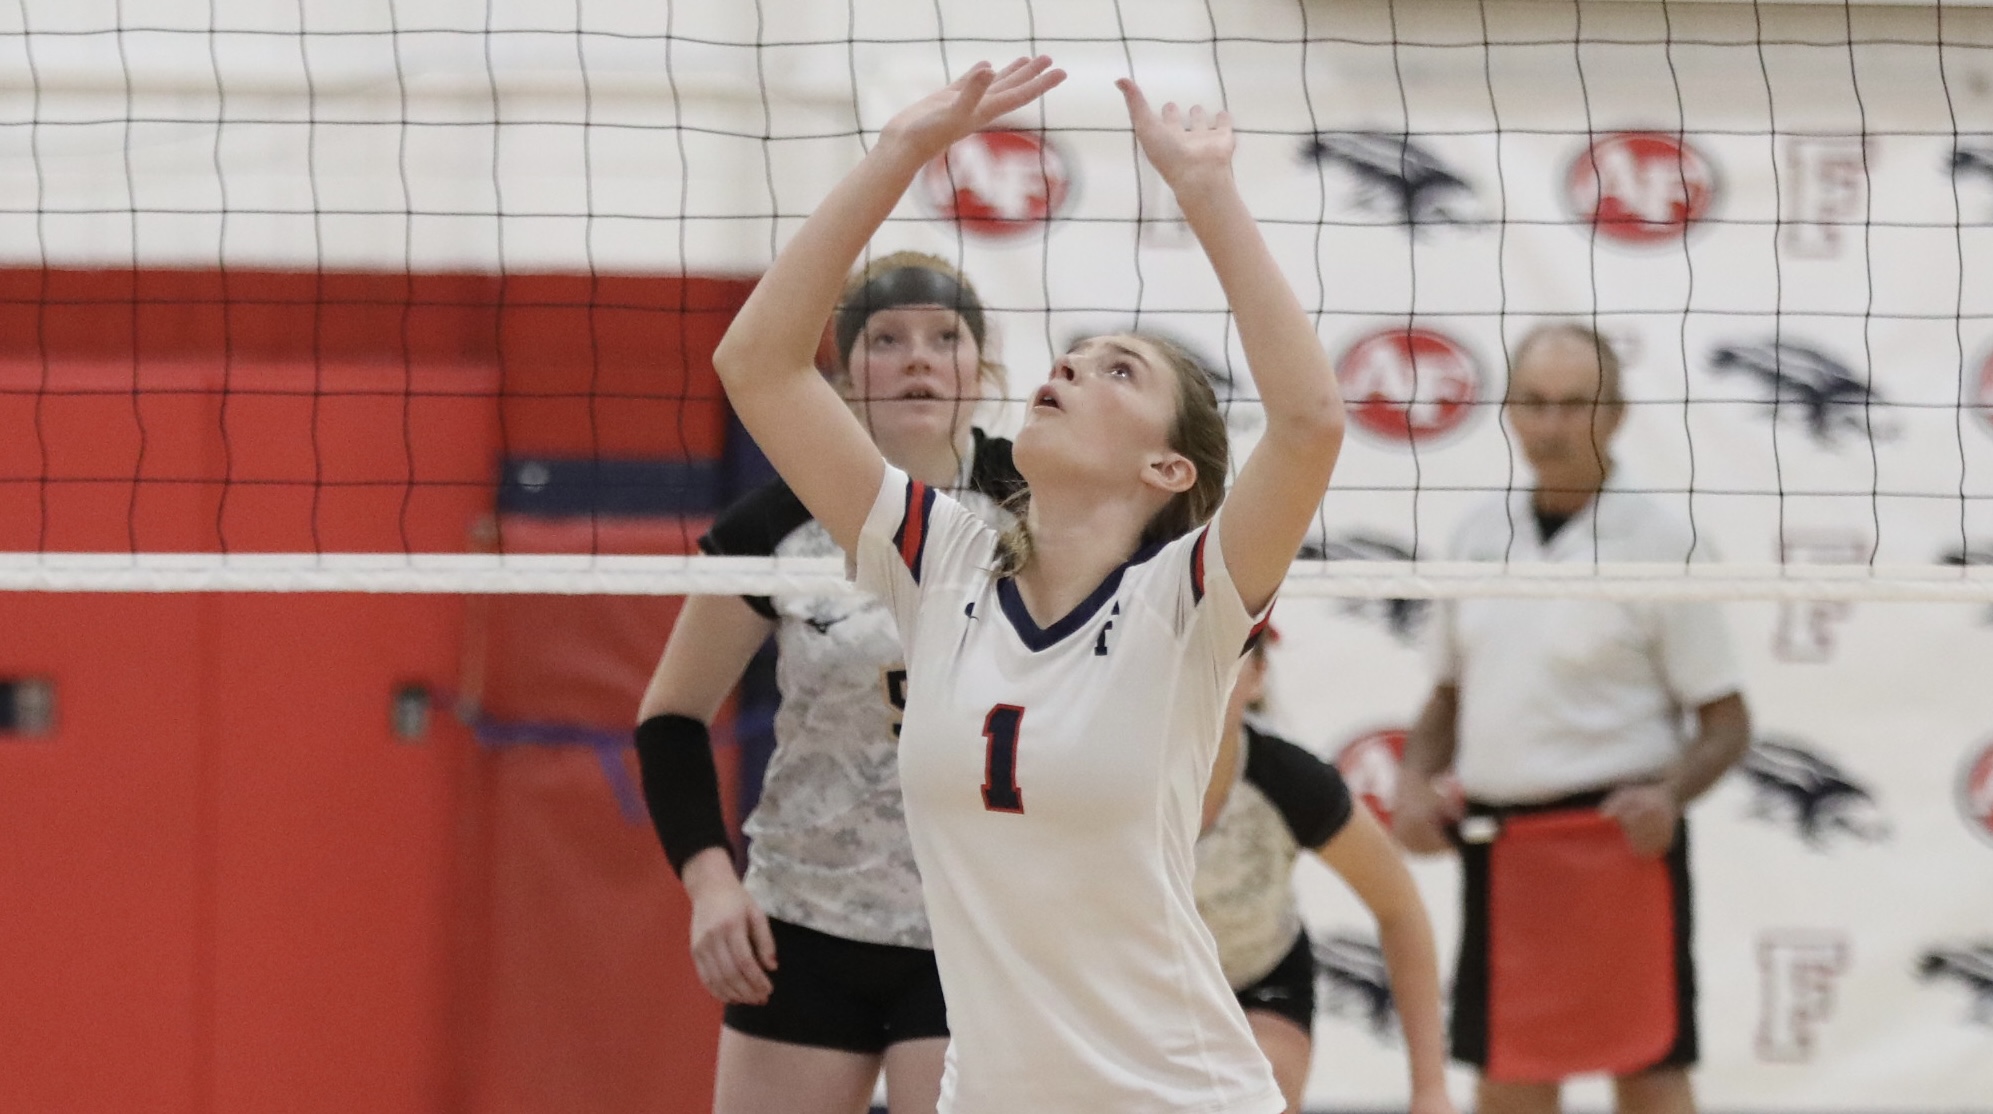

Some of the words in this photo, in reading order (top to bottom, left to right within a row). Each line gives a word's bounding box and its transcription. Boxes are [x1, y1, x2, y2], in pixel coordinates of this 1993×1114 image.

[1571, 138, 1708, 232] AF
[1785, 134, 1879, 260] F
[1340, 336, 1474, 426] AF
[980, 703, 1025, 814] 1
[1755, 928, 1852, 1065] F
